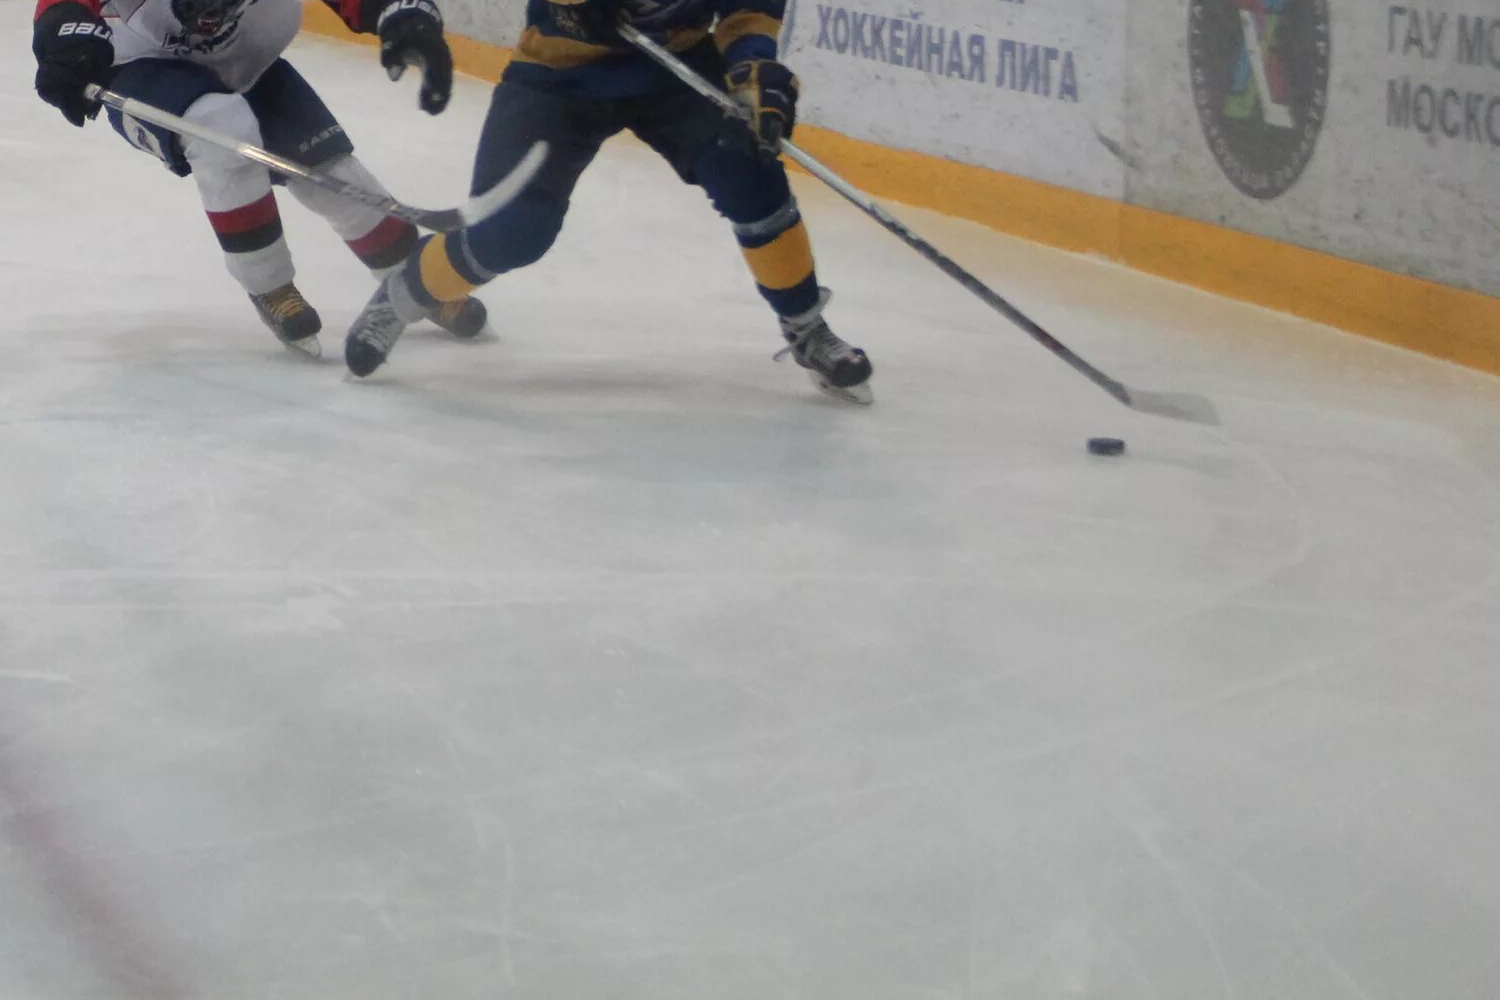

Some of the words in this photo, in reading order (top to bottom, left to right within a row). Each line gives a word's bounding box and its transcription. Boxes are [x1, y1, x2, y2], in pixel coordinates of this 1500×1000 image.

[816, 3, 986, 84] ХОККЕЙНАЯ
[996, 38, 1079, 103] ЛИГА
[1387, 5, 1449, 60] ГАУ
